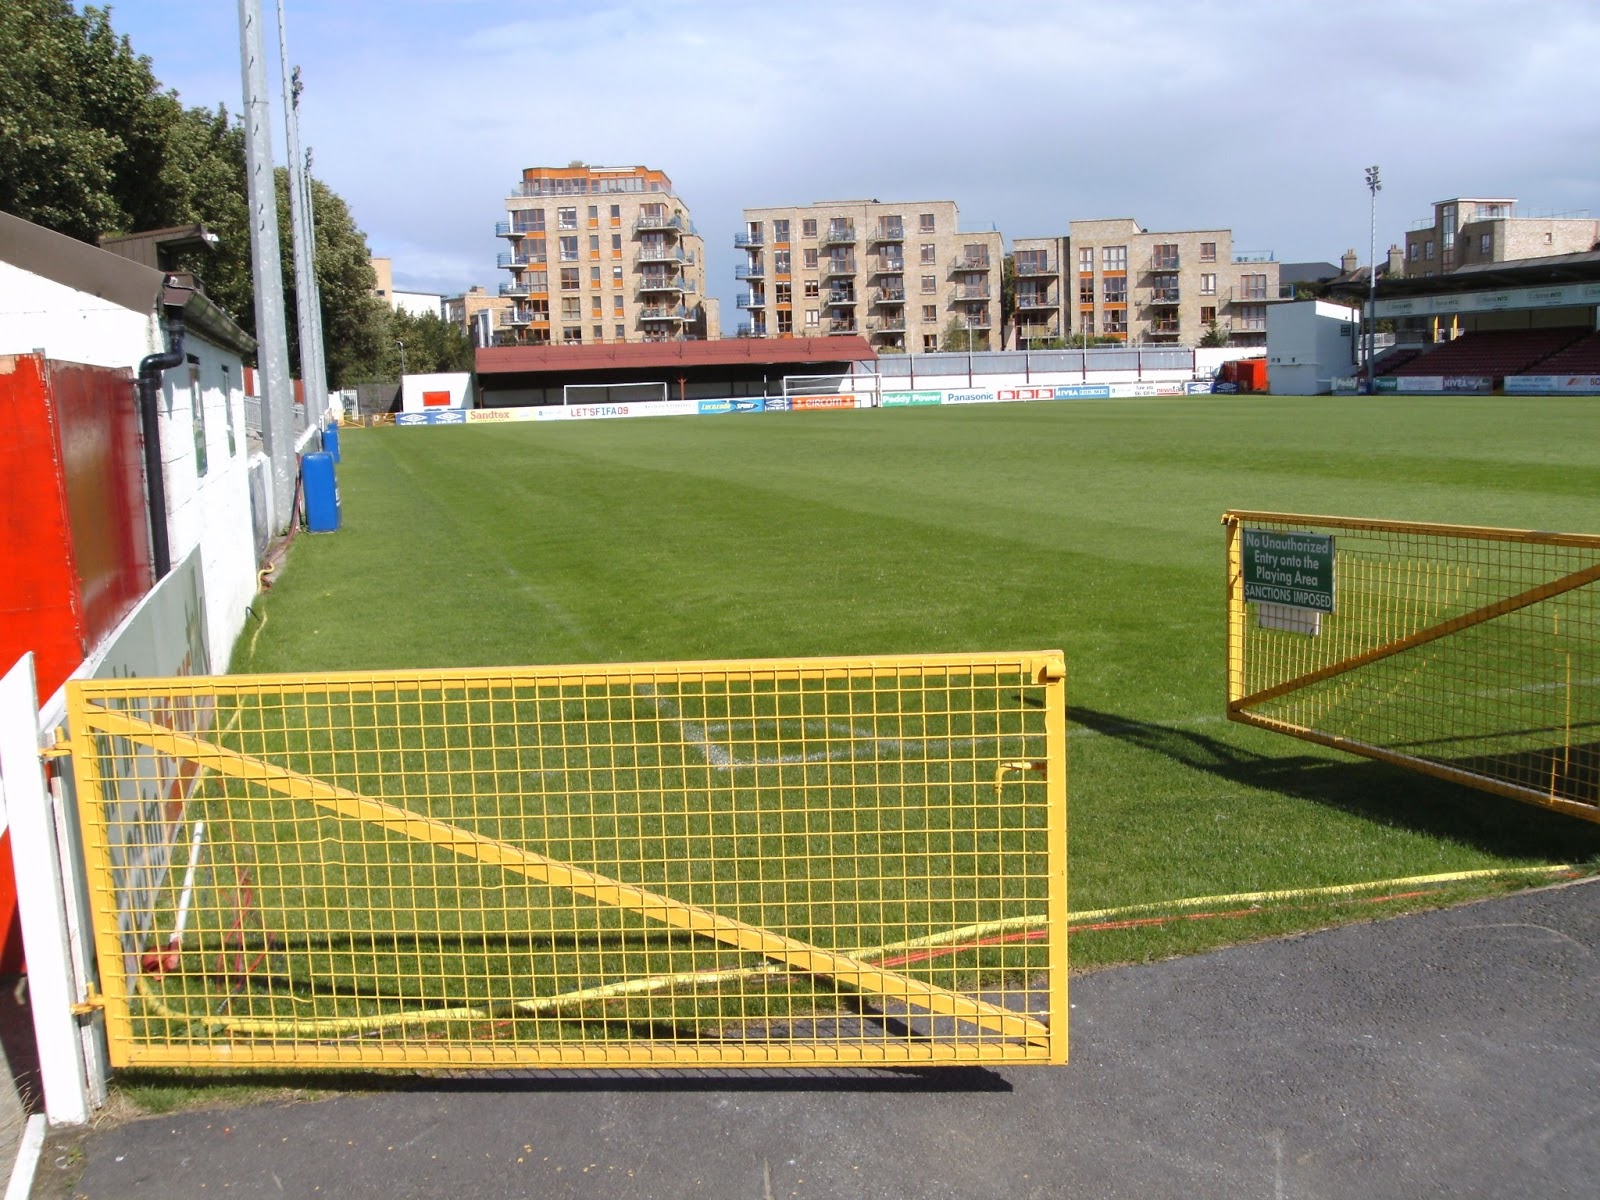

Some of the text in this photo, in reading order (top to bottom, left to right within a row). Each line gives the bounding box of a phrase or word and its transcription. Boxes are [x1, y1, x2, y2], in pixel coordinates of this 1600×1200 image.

[948, 393, 994, 402] Panasonic
[470, 410, 510, 420] Sandtex
[1246, 534, 1329, 554] No Unauthorized
[1254, 550, 1319, 570] Entry onto the
[1256, 566, 1318, 586] Playing Area
[1245, 584, 1332, 608] SANCTIONS IMPOSED
